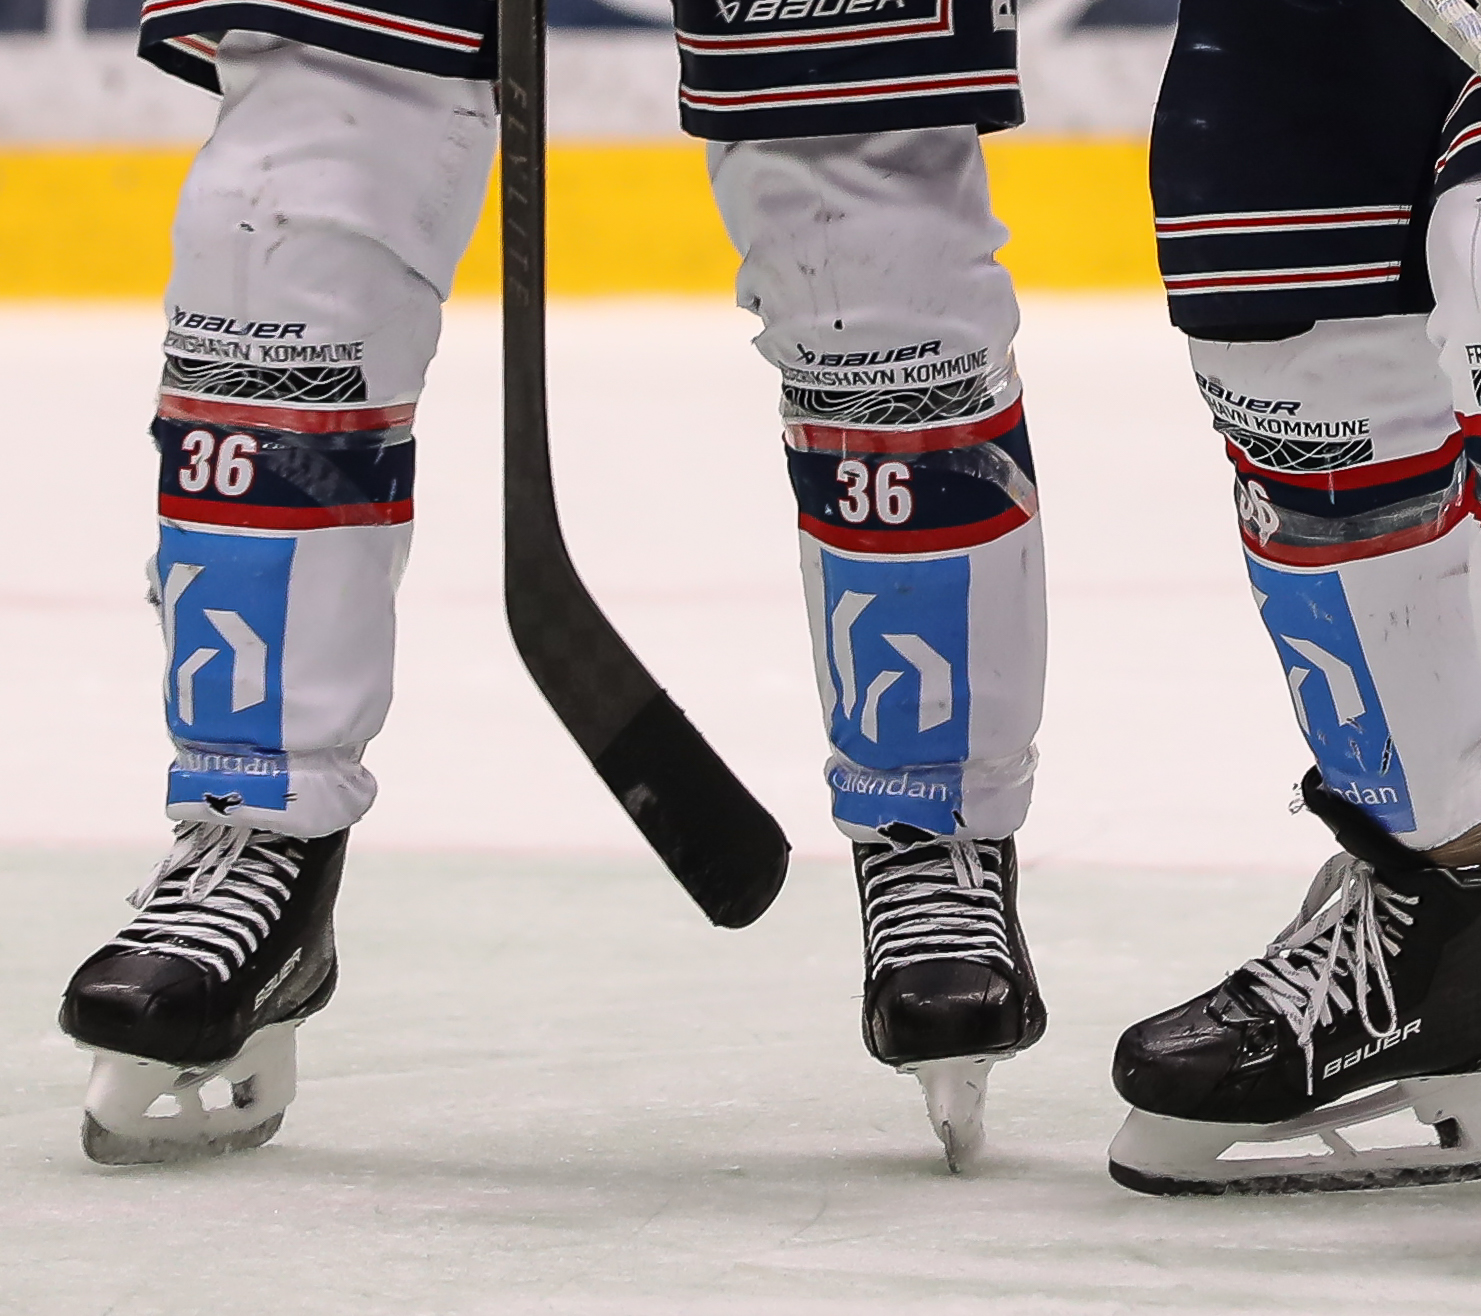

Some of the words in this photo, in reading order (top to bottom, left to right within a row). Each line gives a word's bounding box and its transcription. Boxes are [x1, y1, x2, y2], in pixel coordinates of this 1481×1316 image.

[182, 312, 308, 341] BAUER
[818, 338, 943, 369] BAUER
[901, 346, 989, 386] KOMMUNE
[1252, 416, 1371, 439] KOMMUNE
[178, 429, 260, 498] 36
[837, 459, 913, 526] 36
[1322, 1017, 1423, 1081] BAUER
